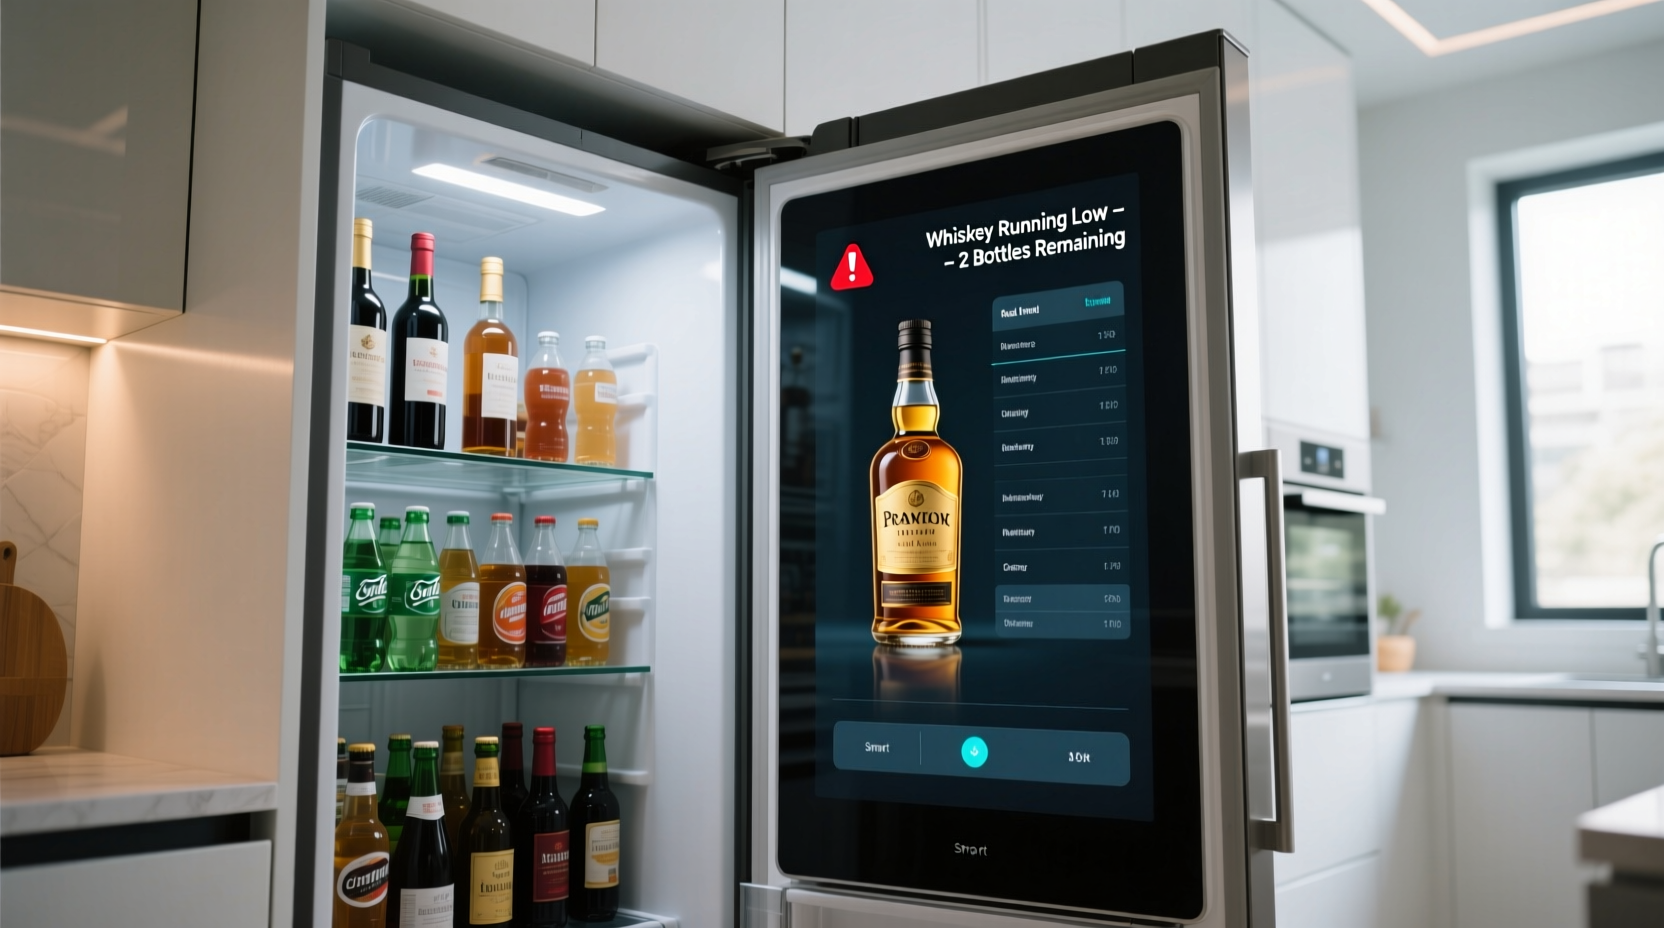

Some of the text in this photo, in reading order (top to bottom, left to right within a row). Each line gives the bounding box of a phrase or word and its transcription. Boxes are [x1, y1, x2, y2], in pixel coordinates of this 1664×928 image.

[926, 225, 994, 249] Whiskey
[998, 211, 1068, 237] Running
[1072, 206, 1108, 225] Low
[959, 251, 969, 269] 2
[973, 243, 1031, 267] Bottles
[1035, 229, 1126, 257] Remaining
